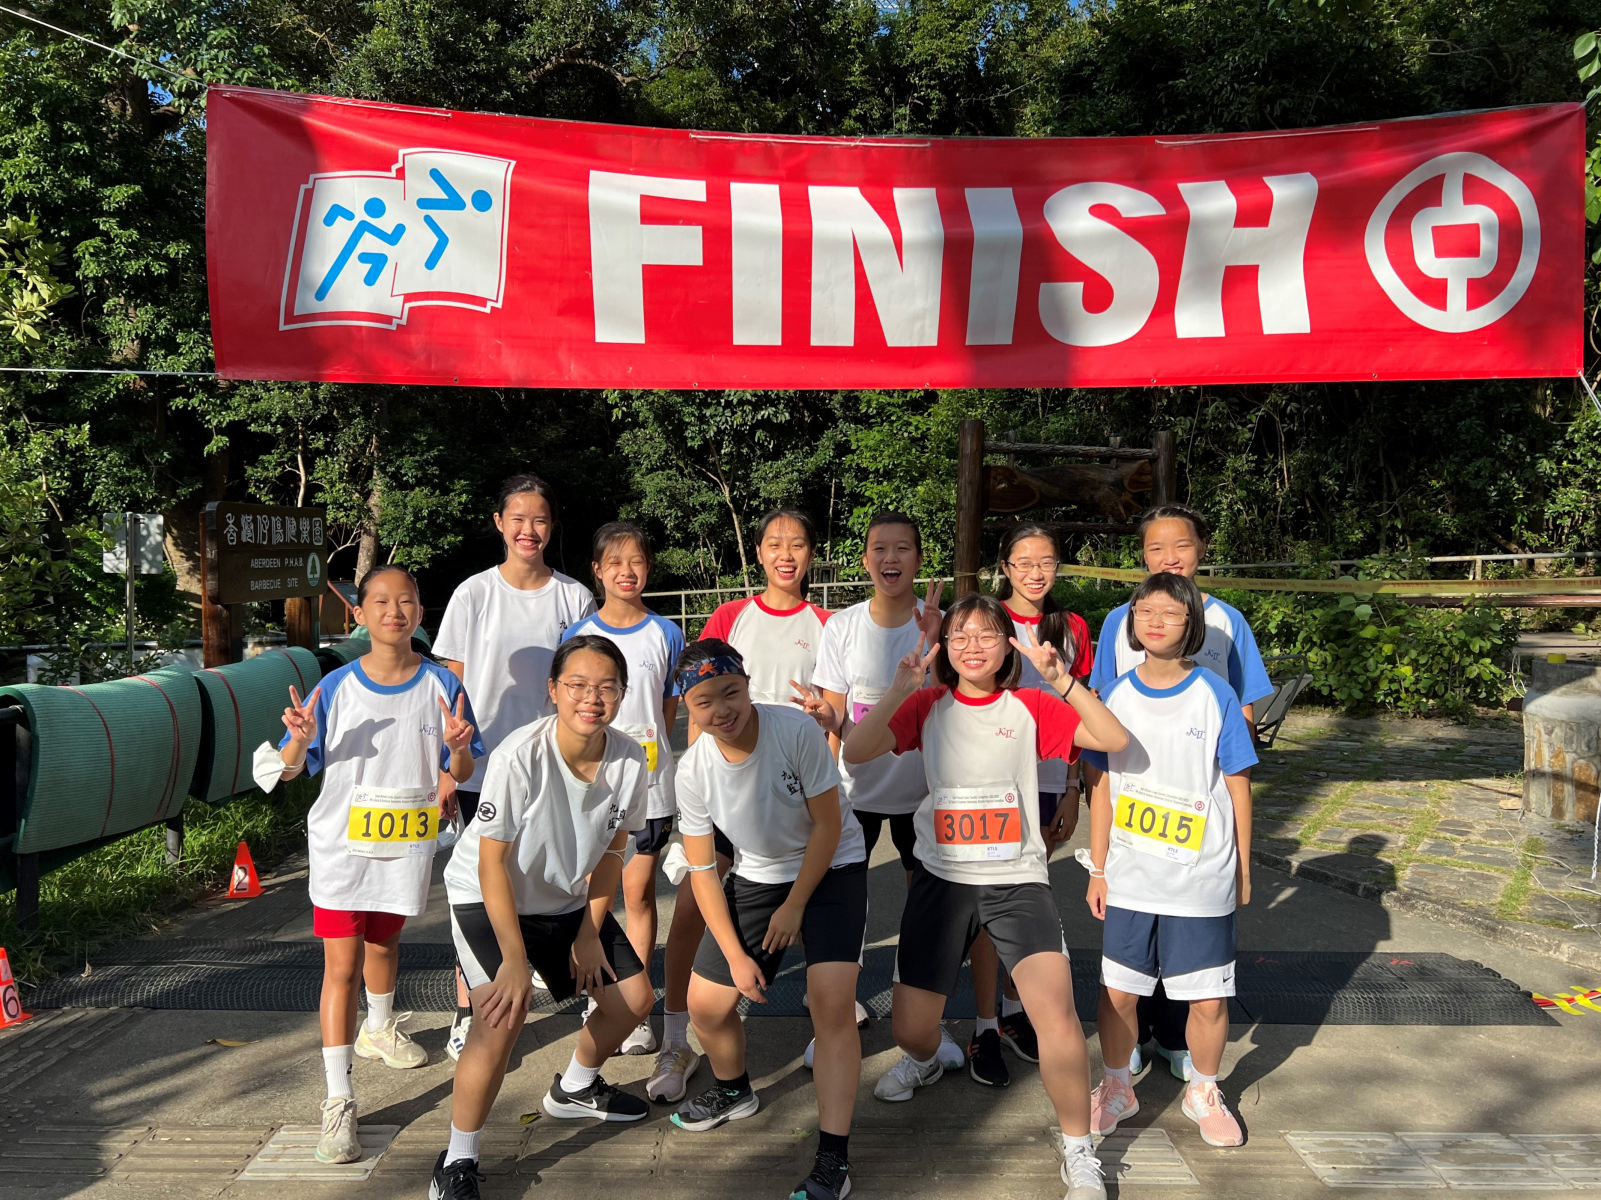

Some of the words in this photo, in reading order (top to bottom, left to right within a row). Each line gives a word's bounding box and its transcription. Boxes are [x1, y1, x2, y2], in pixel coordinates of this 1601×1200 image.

[588, 170, 1318, 348] FINISH
[250, 558, 280, 568] ABERDEEN
[285, 558, 304, 567] P.H.A.B.
[250, 579, 281, 590] BARBECUE
[287, 578, 299, 588] SITE
[361, 811, 429, 839] 1013
[944, 813, 1010, 841] 3017
[1125, 802, 1193, 844] 1015
[234, 866, 248, 892] 2
[2, 984, 20, 1019] 6
